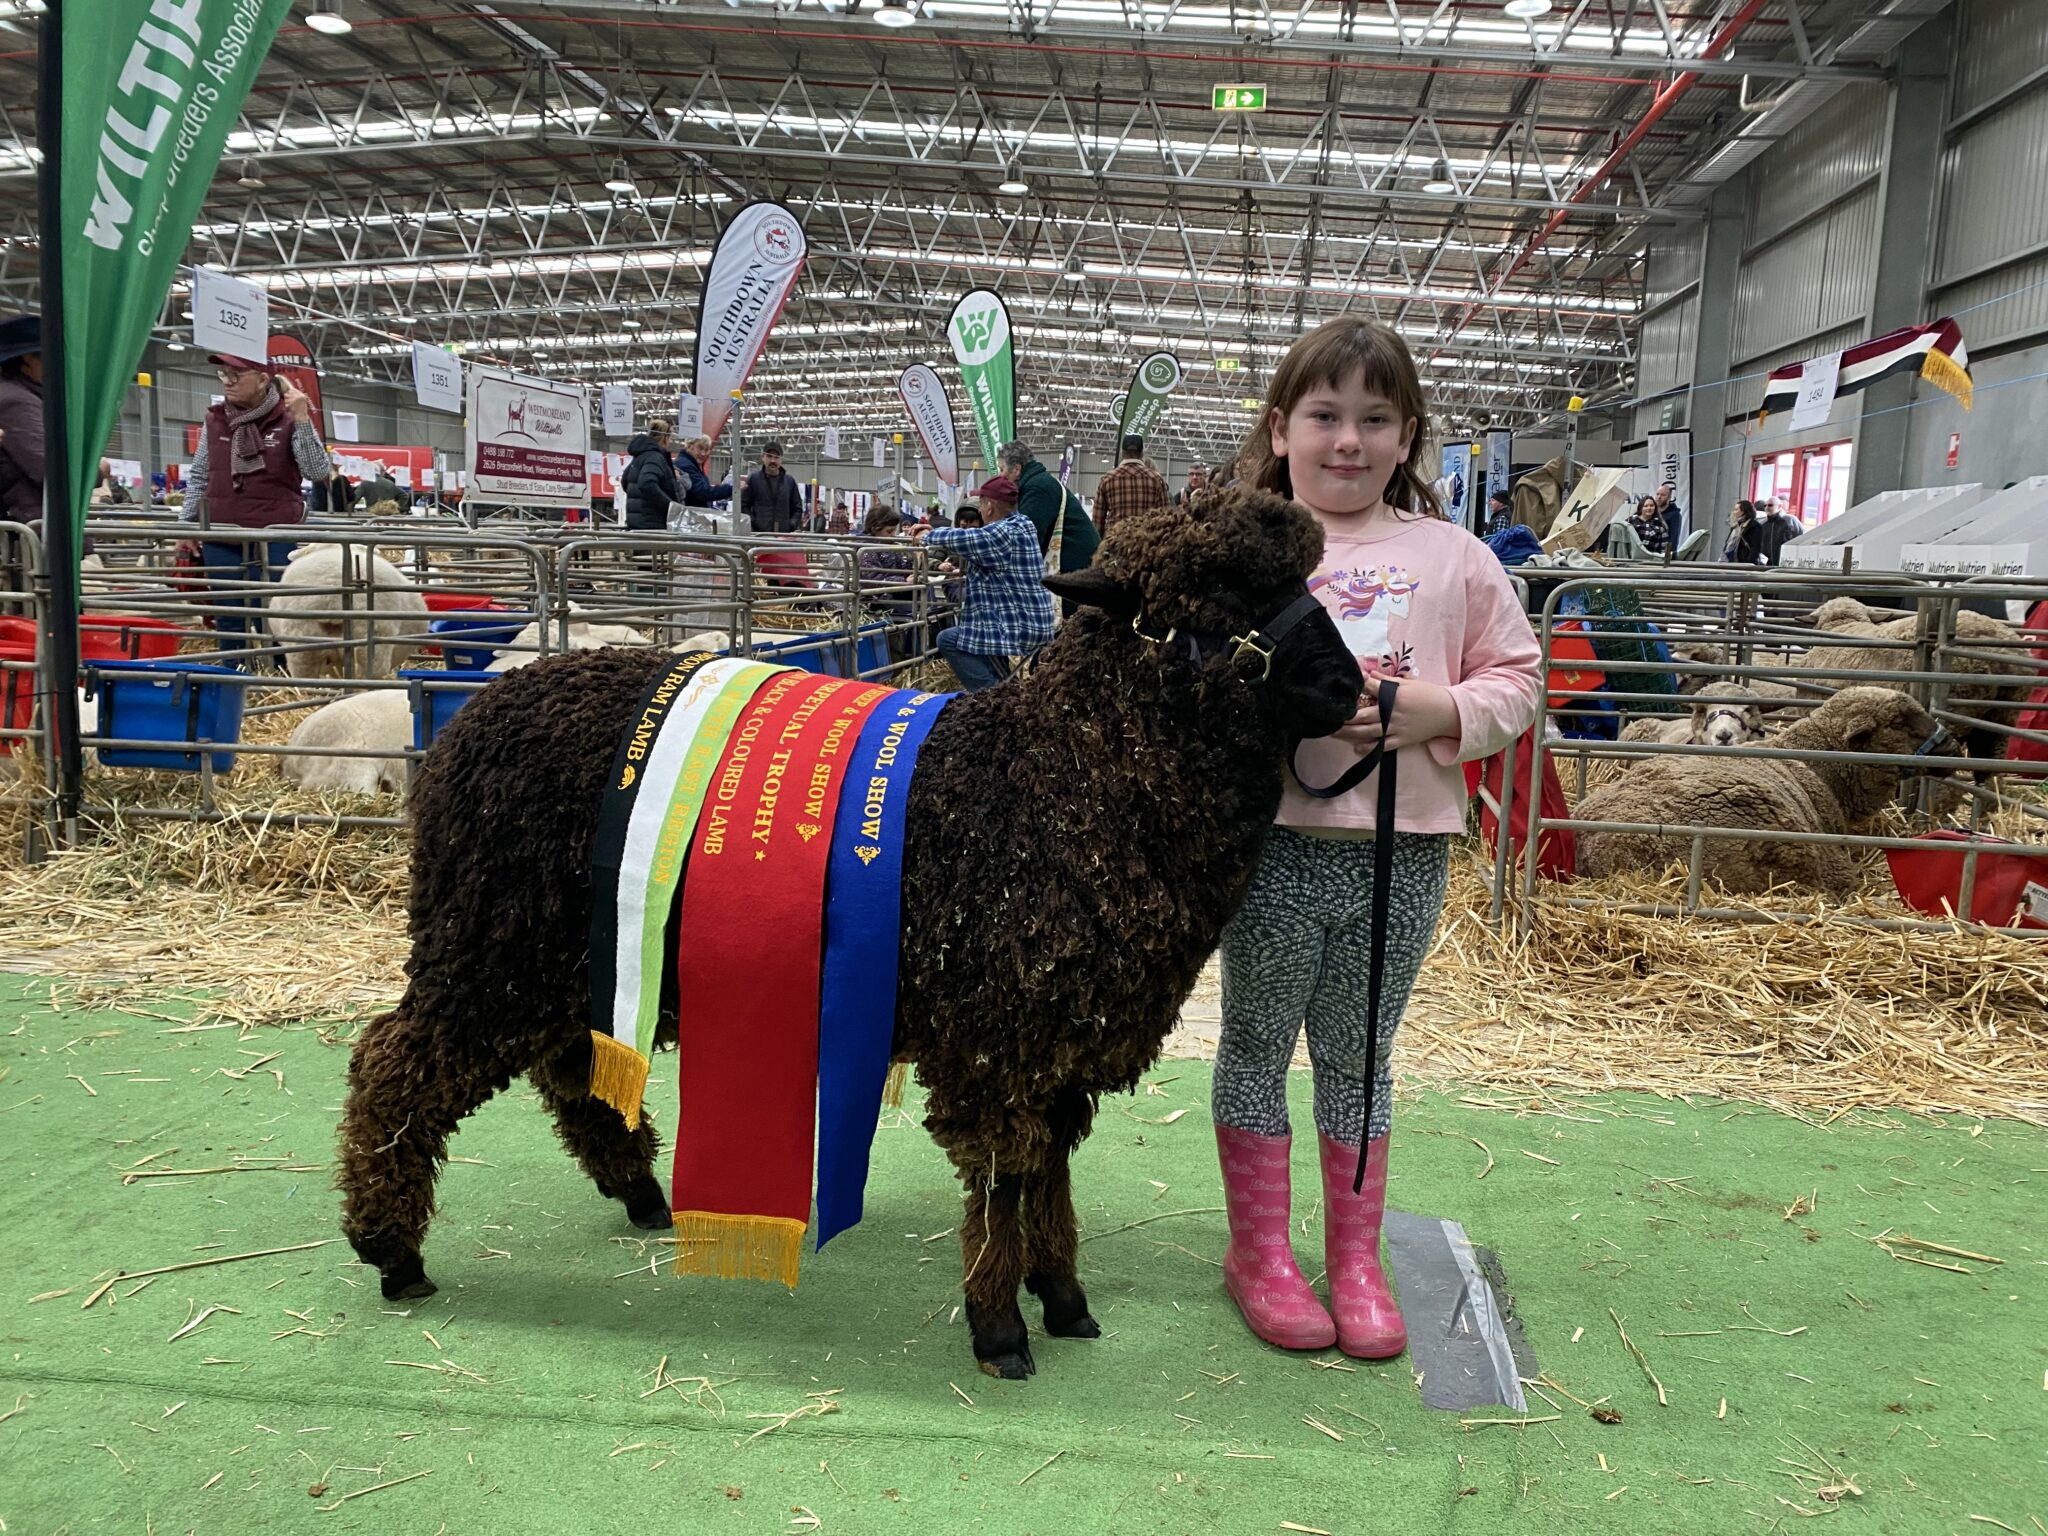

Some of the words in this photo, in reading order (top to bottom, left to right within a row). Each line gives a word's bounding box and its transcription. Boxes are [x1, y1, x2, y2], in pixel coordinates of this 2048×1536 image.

[219, 308, 248, 330] 1352
[702, 258, 764, 369] SOUTHDOWN
[721, 277, 776, 371] AUSTRALIA
[431, 372, 449, 388] 1351
[528, 403, 571, 421] WESTMORELAND
[917, 403, 945, 454] AUSTRALIA
[922, 393, 954, 454] SOUTHDOWN
[976, 370, 1003, 474] WILTIP
[1140, 398, 1160, 427] Sheep
[651, 672, 686, 705] RAM
[751, 706, 773, 716] &
[760, 677, 801, 705] BLACK
[896, 707, 917, 717] &
[626, 707, 663, 762] LAMB
[717, 717, 764, 801] COLOURED
[819, 718, 853, 758] WOOL
[874, 721, 909, 770] WOOL
[751, 748, 792, 845] TROPHY
[804, 763, 832, 819] SHOW
[860, 776, 888, 841] SHOW
[703, 804, 732, 855] LAMB
